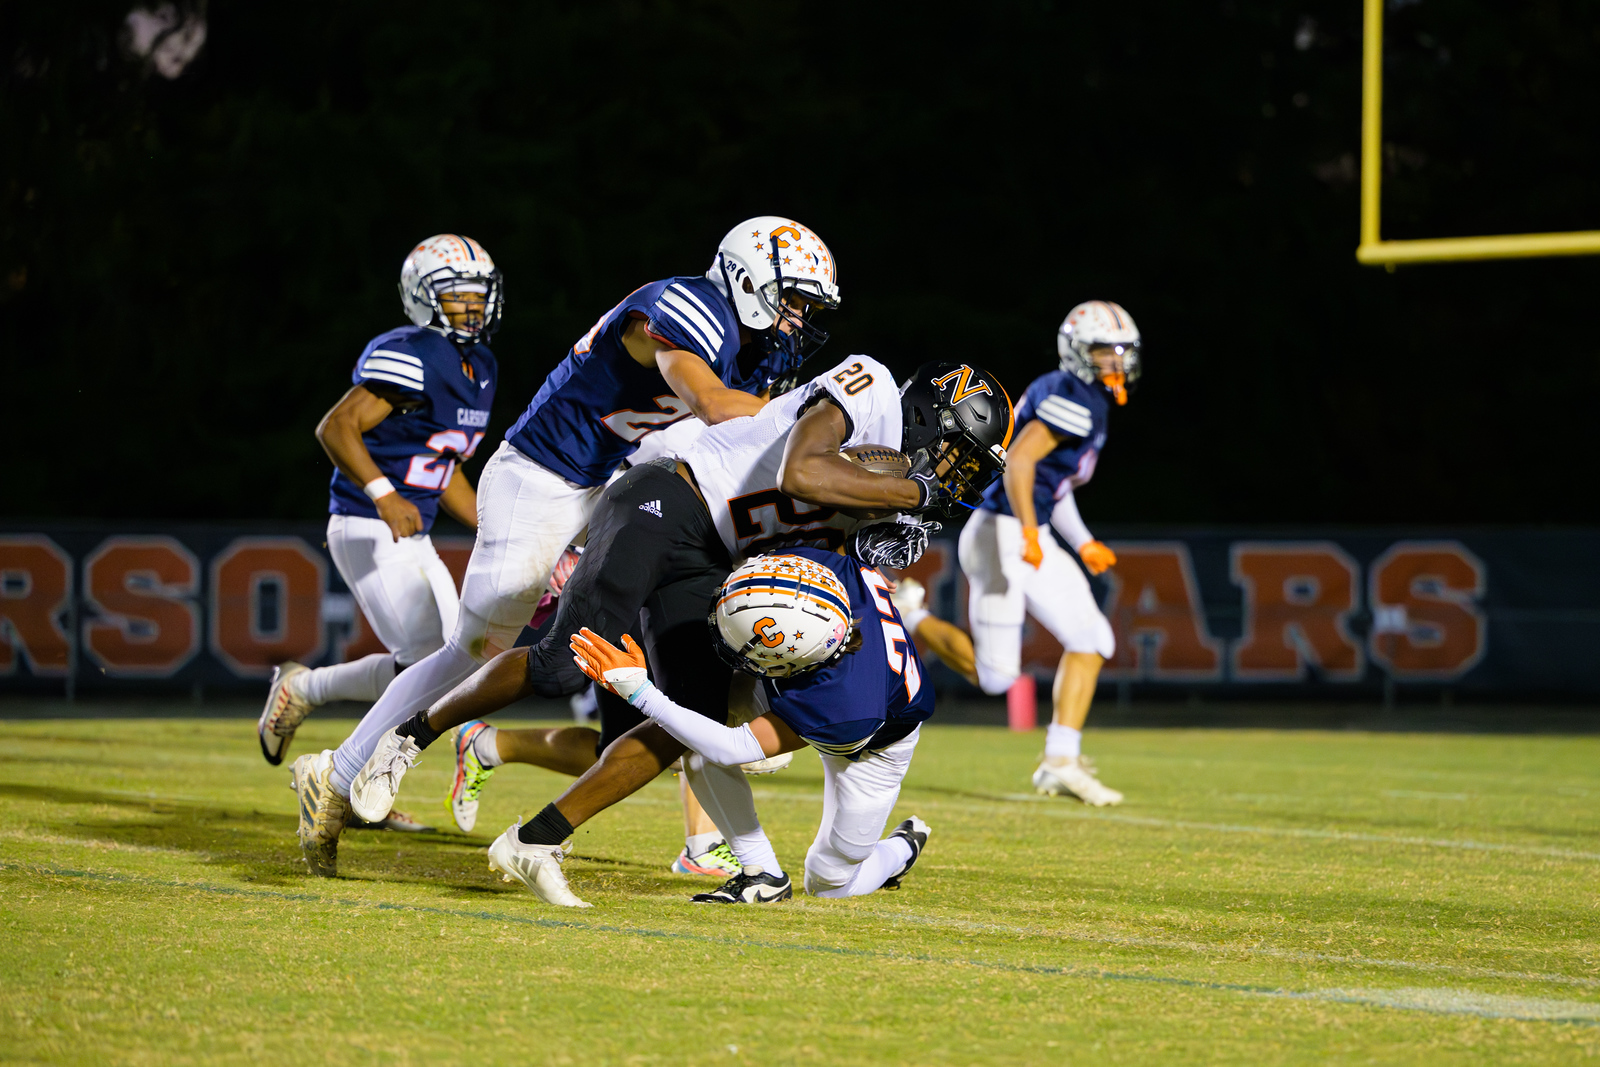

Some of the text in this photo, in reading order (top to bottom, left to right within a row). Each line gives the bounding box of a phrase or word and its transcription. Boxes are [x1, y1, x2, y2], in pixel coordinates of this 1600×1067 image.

[725, 260, 737, 273] 29
[831, 361, 875, 397] 20
[930, 363, 993, 406] N
[638, 503, 663, 518] adidas
[0, 534, 474, 680] RSO
